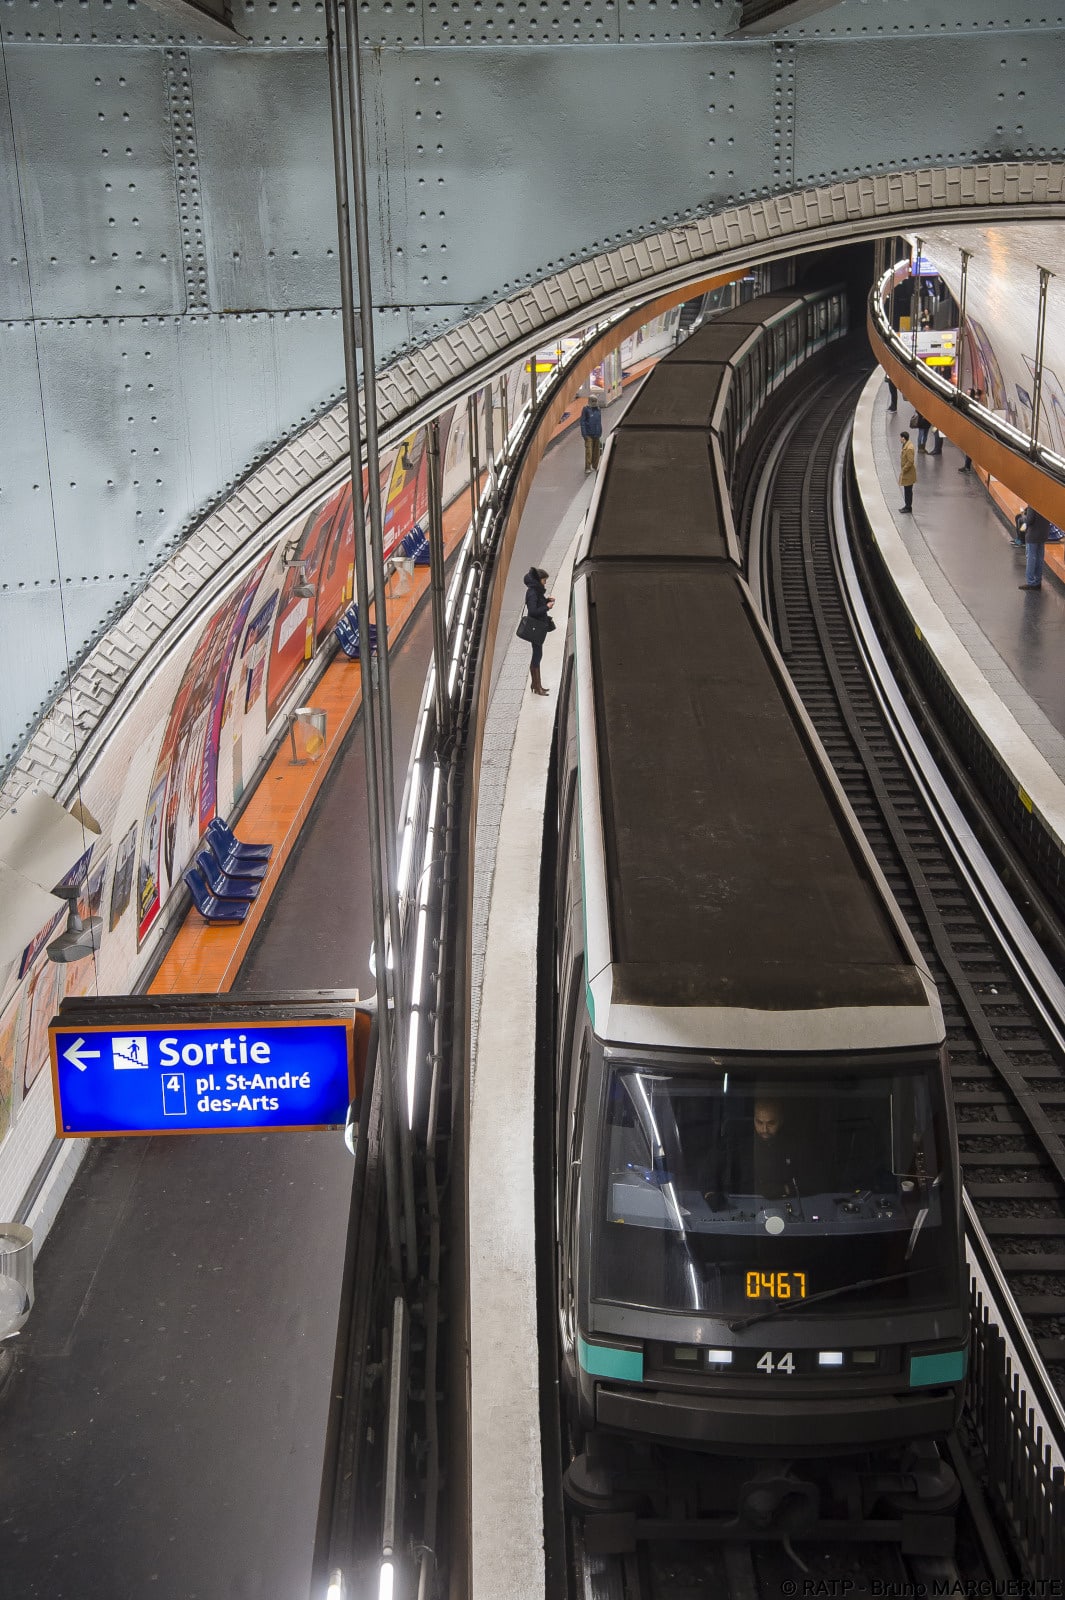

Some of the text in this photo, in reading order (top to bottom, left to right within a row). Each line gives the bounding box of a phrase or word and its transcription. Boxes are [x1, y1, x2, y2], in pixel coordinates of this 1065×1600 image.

[159, 1034, 271, 1067] Sortie
[167, 1071, 311, 1095] 4 pl. St-André
[198, 1095, 279, 1112] des-Arts
[746, 1271, 806, 1299] 0467
[756, 1351, 796, 1375] 44
